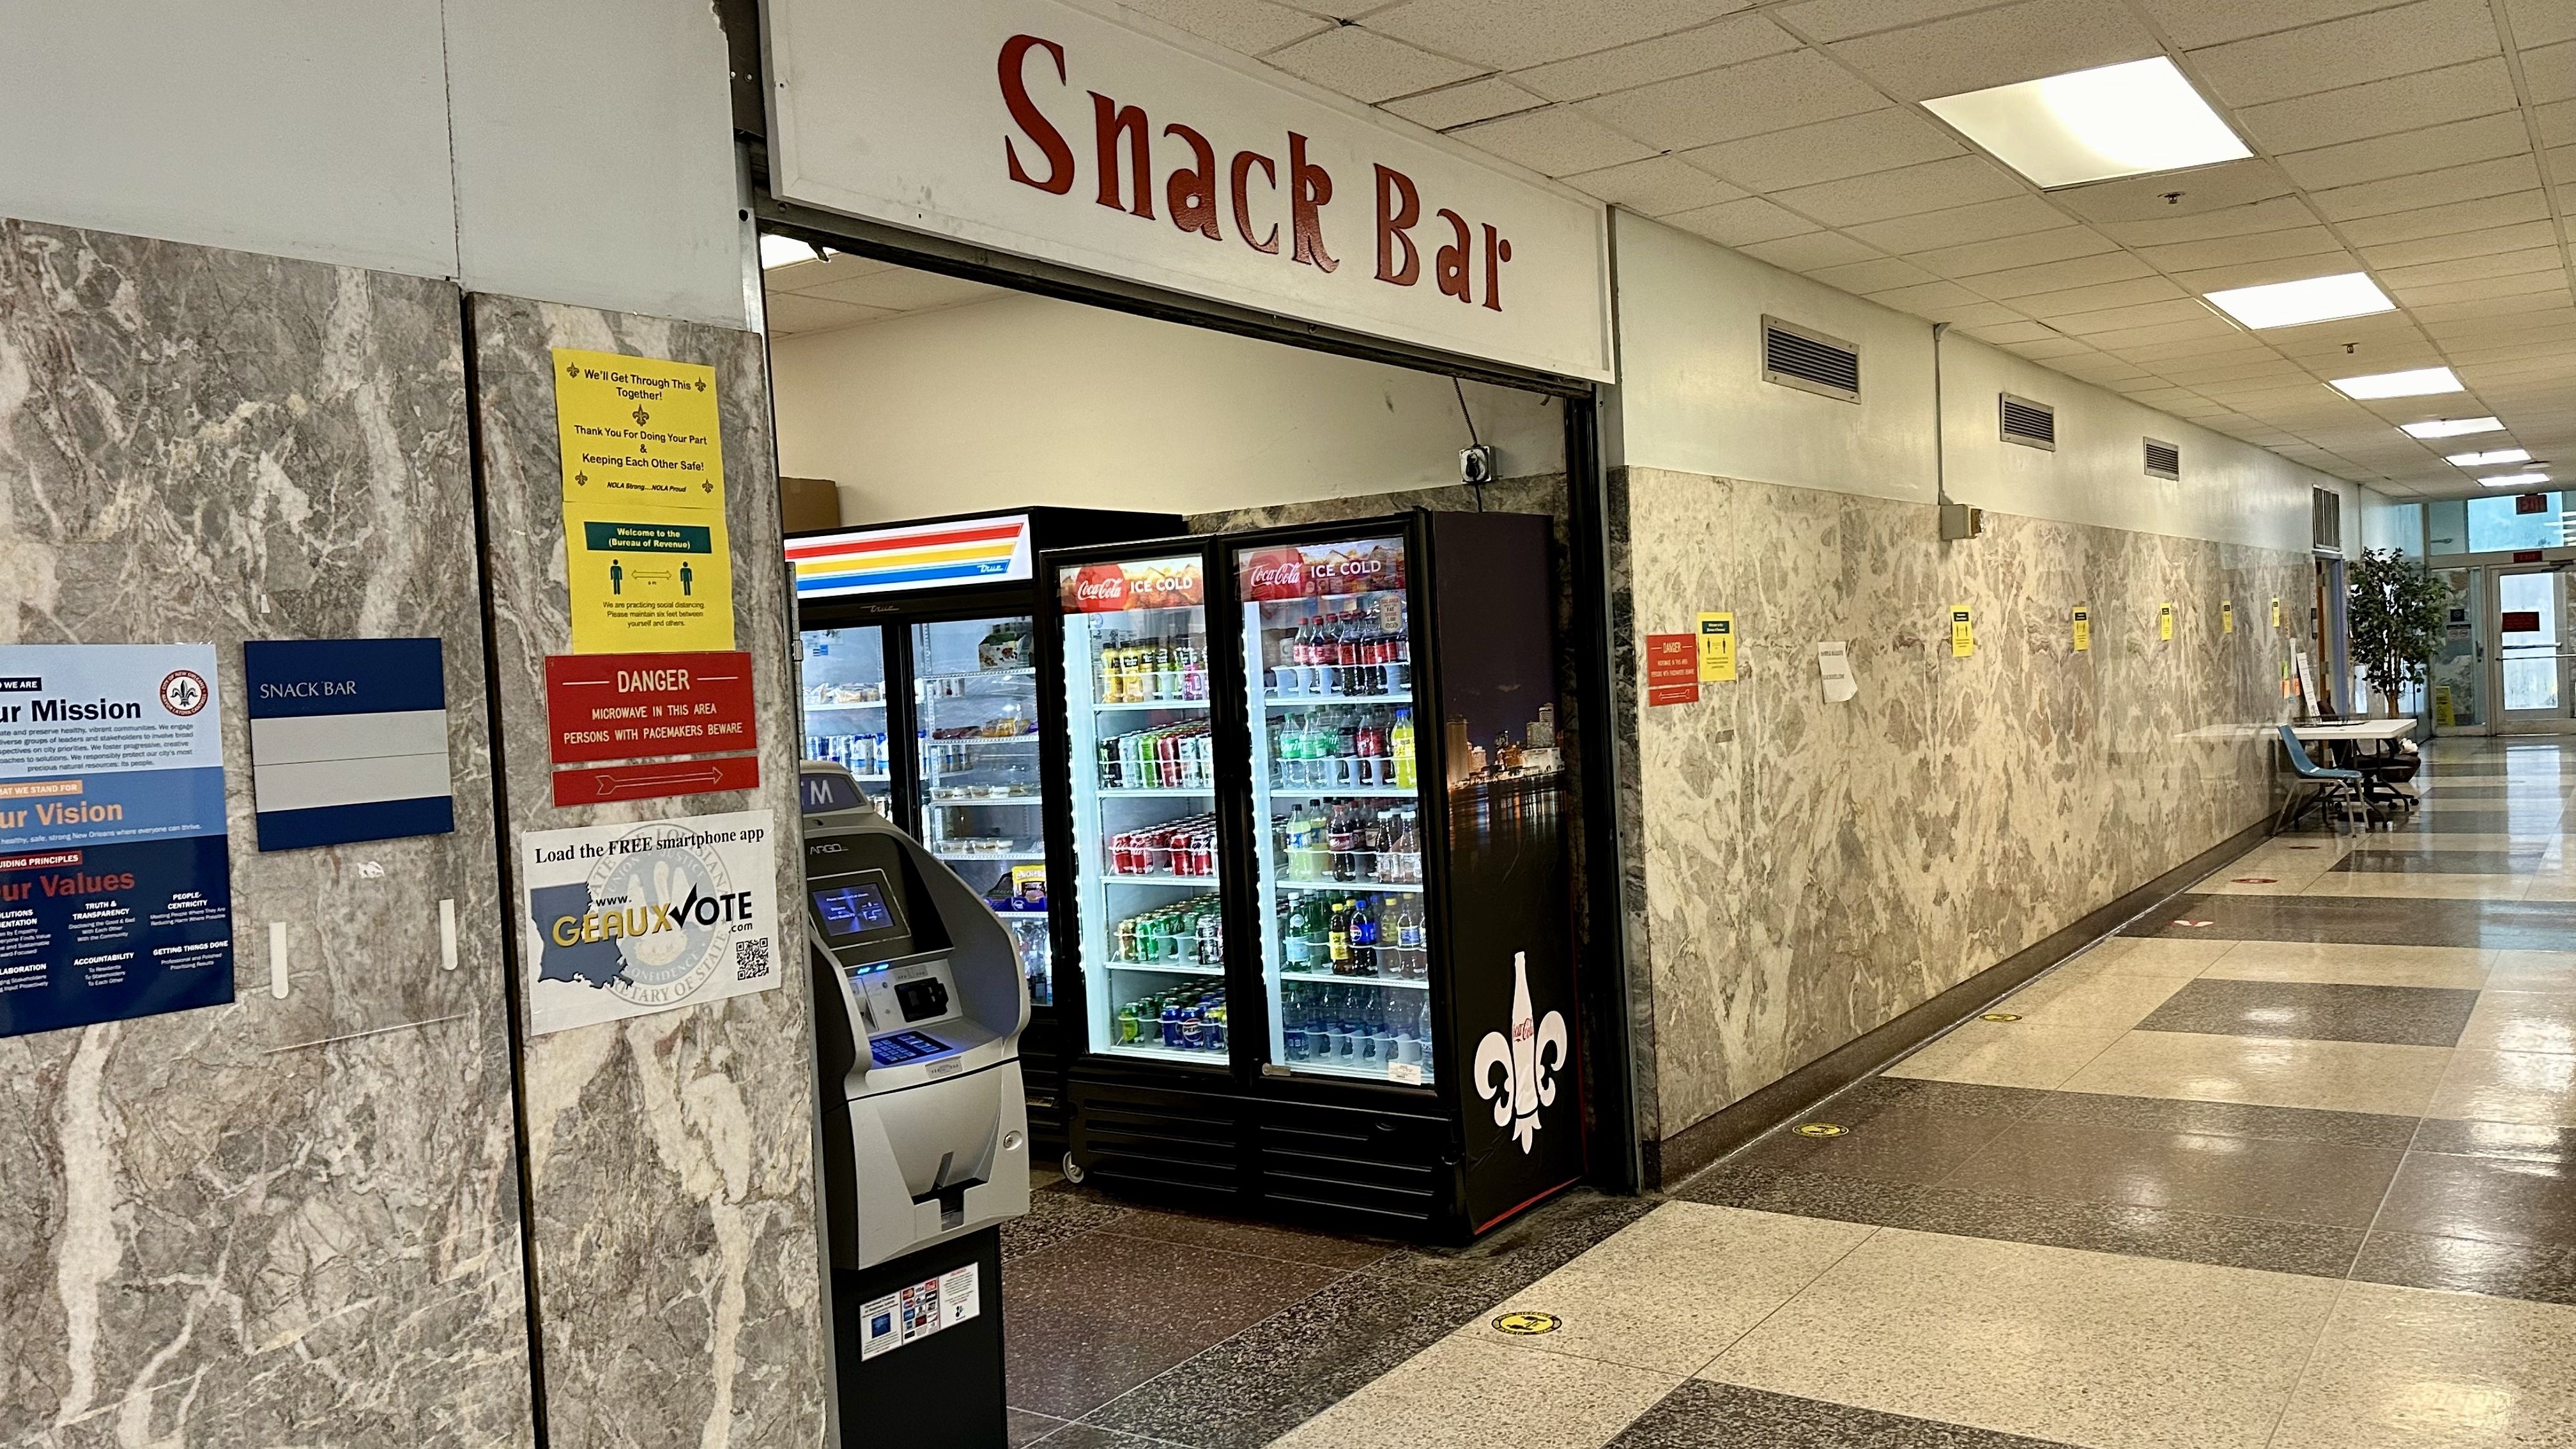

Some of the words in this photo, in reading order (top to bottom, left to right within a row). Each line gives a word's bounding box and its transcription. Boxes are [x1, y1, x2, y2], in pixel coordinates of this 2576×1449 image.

[997, 34, 1340, 273] Snack
[1374, 163, 1512, 312] Bar
[585, 369, 608, 381] We'll
[611, 372, 628, 383] Get
[630, 374, 670, 388] Through
[672, 379, 691, 390] This
[616, 387, 663, 401] Together!
[574, 425, 602, 436] Thank
[604, 428, 621, 437] You
[624, 430, 638, 438] For
[640, 431, 666, 443] Doing
[668, 433, 687, 443] Your
[689, 436, 707, 445] Part
[640, 444, 647, 453] &
[583, 454, 623, 467] Keeping
[625, 457, 648, 467] Each
[652, 459, 678, 469] Other
[681, 461, 704, 471] Safe!
[617, 528, 654, 537] Welcome
[609, 538, 640, 547] (Bureau
[654, 541, 690, 549] Revenue)
[1311, 564, 1336, 578] ICE
[1340, 560, 1381, 575] COLD
[1131, 581, 1153, 593] ICE
[1156, 577, 1193, 591] COLD
[628, 620, 651, 628] yourself
[617, 670, 690, 693] DANGER
[260, 682, 319, 698] SNACK
[324, 680, 357, 695] BAR
[0, 706, 21, 723] ur
[31, 698, 141, 723] Mission
[592, 705, 648, 720] MICROWAVE
[653, 705, 663, 717] IN
[668, 705, 689, 716] THIS
[694, 703, 717, 714] AREA
[29, 728, 58, 737] preserve
[564, 730, 610, 744] PERSONS
[615, 728, 638, 741] WITH
[643, 724, 703, 739] PACEMAKERS
[708, 723, 742, 735] BEWARE
[83, 753, 120, 761] responsibly
[32, 785, 58, 793] STAND
[0, 810, 27, 829] ur
[34, 801, 123, 826] Vision
[49, 833, 71, 841] strong
[535, 845, 574, 863] Load
[580, 843, 604, 859] the
[609, 837, 652, 855] FREE
[657, 829, 736, 851] smartphone
[740, 828, 764, 843] app
[0, 859, 27, 868] UIDING
[29, 855, 79, 866] PRINCIPLES
[608, 855, 640, 893] UNION
[660, 849, 705, 880] JUSTICE
[2, 882, 31, 901] ur
[39, 871, 135, 897] Values
[86, 901, 109, 910] TRUTH
[167, 900, 208, 909] CENTRICITY
[595, 895, 632, 907] www.
[0, 909, 33, 919] OLUTIONS
[72, 908, 130, 920] TRANSPARENCY
[0, 918, 37, 928] ENTATION
[153, 946, 182, 956] GETTING
[184, 943, 209, 952] THINGS
[210, 940, 229, 949] DONE
[73, 952, 134, 966] ACCOUNTABILITY
[674, 976, 695, 997] OF
[696, 931, 728, 980] STATE
[0, 963, 47, 975] LABORATION
